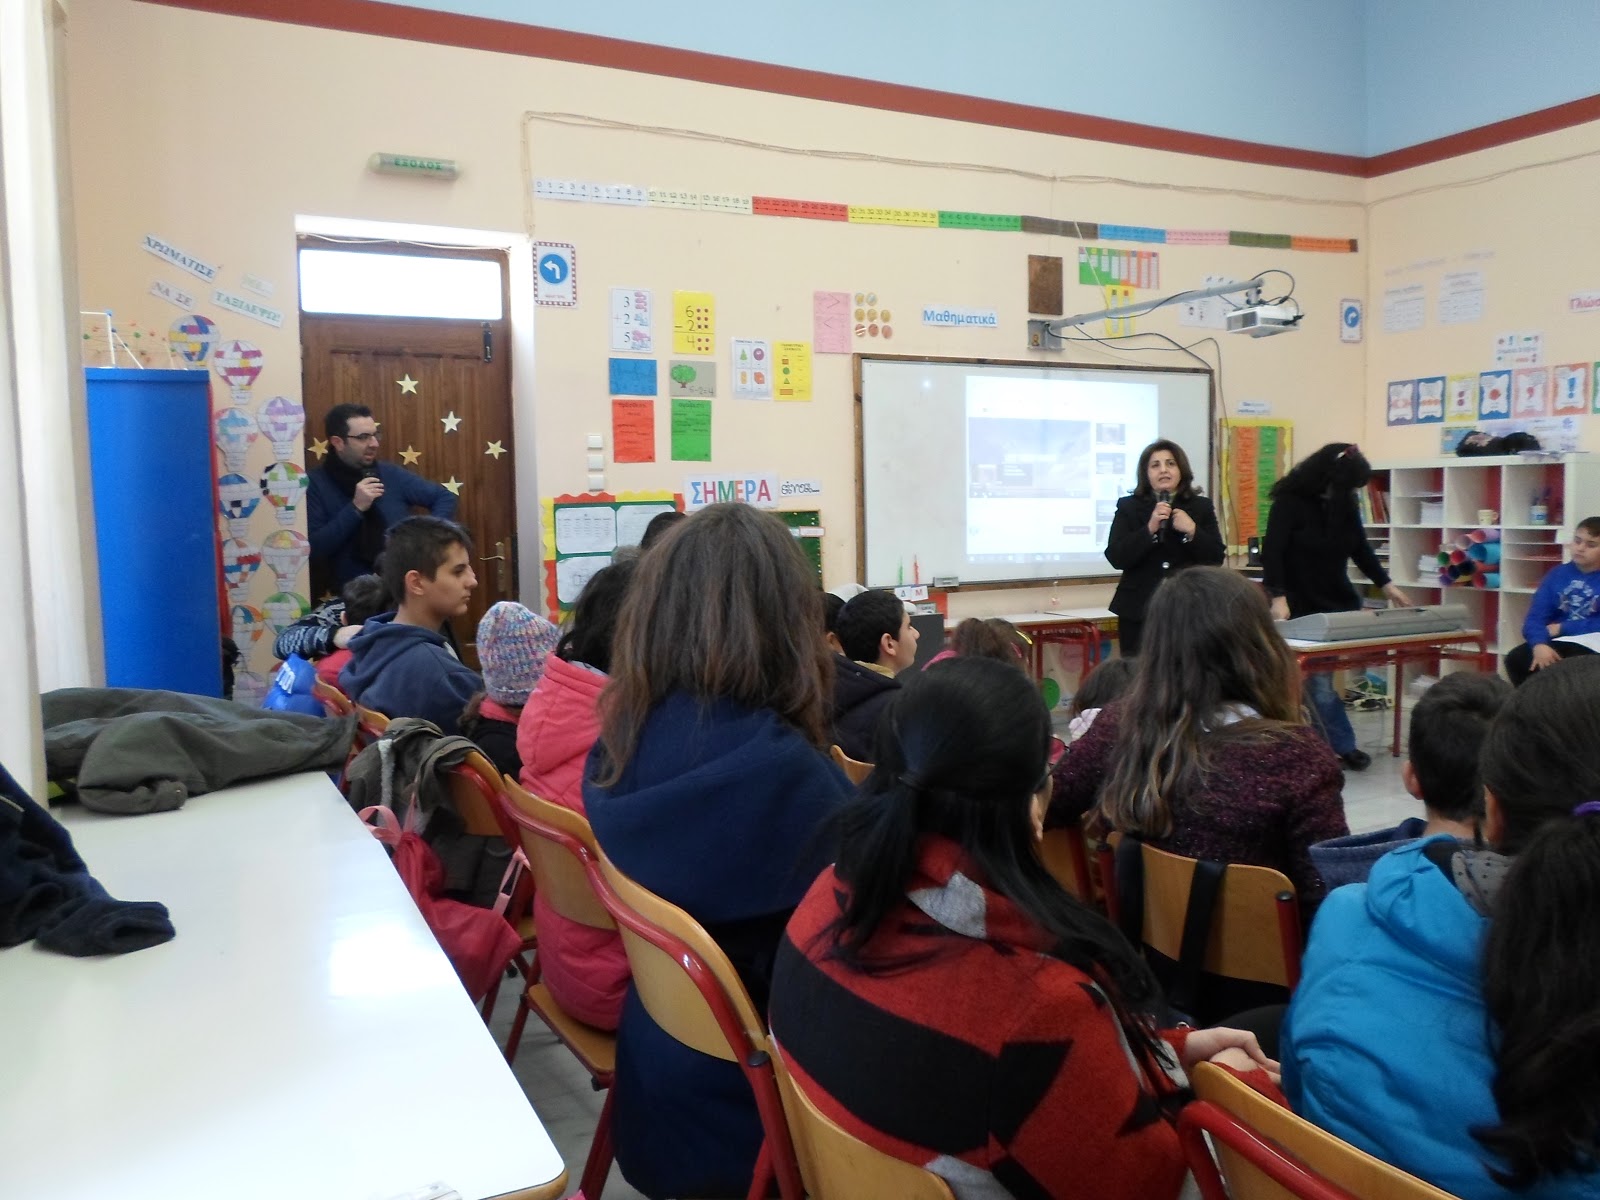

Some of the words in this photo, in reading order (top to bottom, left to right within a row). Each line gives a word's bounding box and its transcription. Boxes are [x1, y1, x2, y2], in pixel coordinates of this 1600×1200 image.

[144, 236, 215, 279] ΧΡΩΜΑΤΙΣΕ
[153, 281, 170, 297] ΝΑ
[175, 293, 192, 307] ΣΕ
[624, 296, 630, 308] 3
[686, 305, 694, 318] 6
[923, 309, 997, 326] Μαθηματικά
[624, 313, 630, 324] 2
[688, 319, 695, 331] 2
[624, 332, 630, 343] 5
[687, 336, 696, 348] 4
[691, 479, 772, 504] ΣΗΜΕΡΑ
